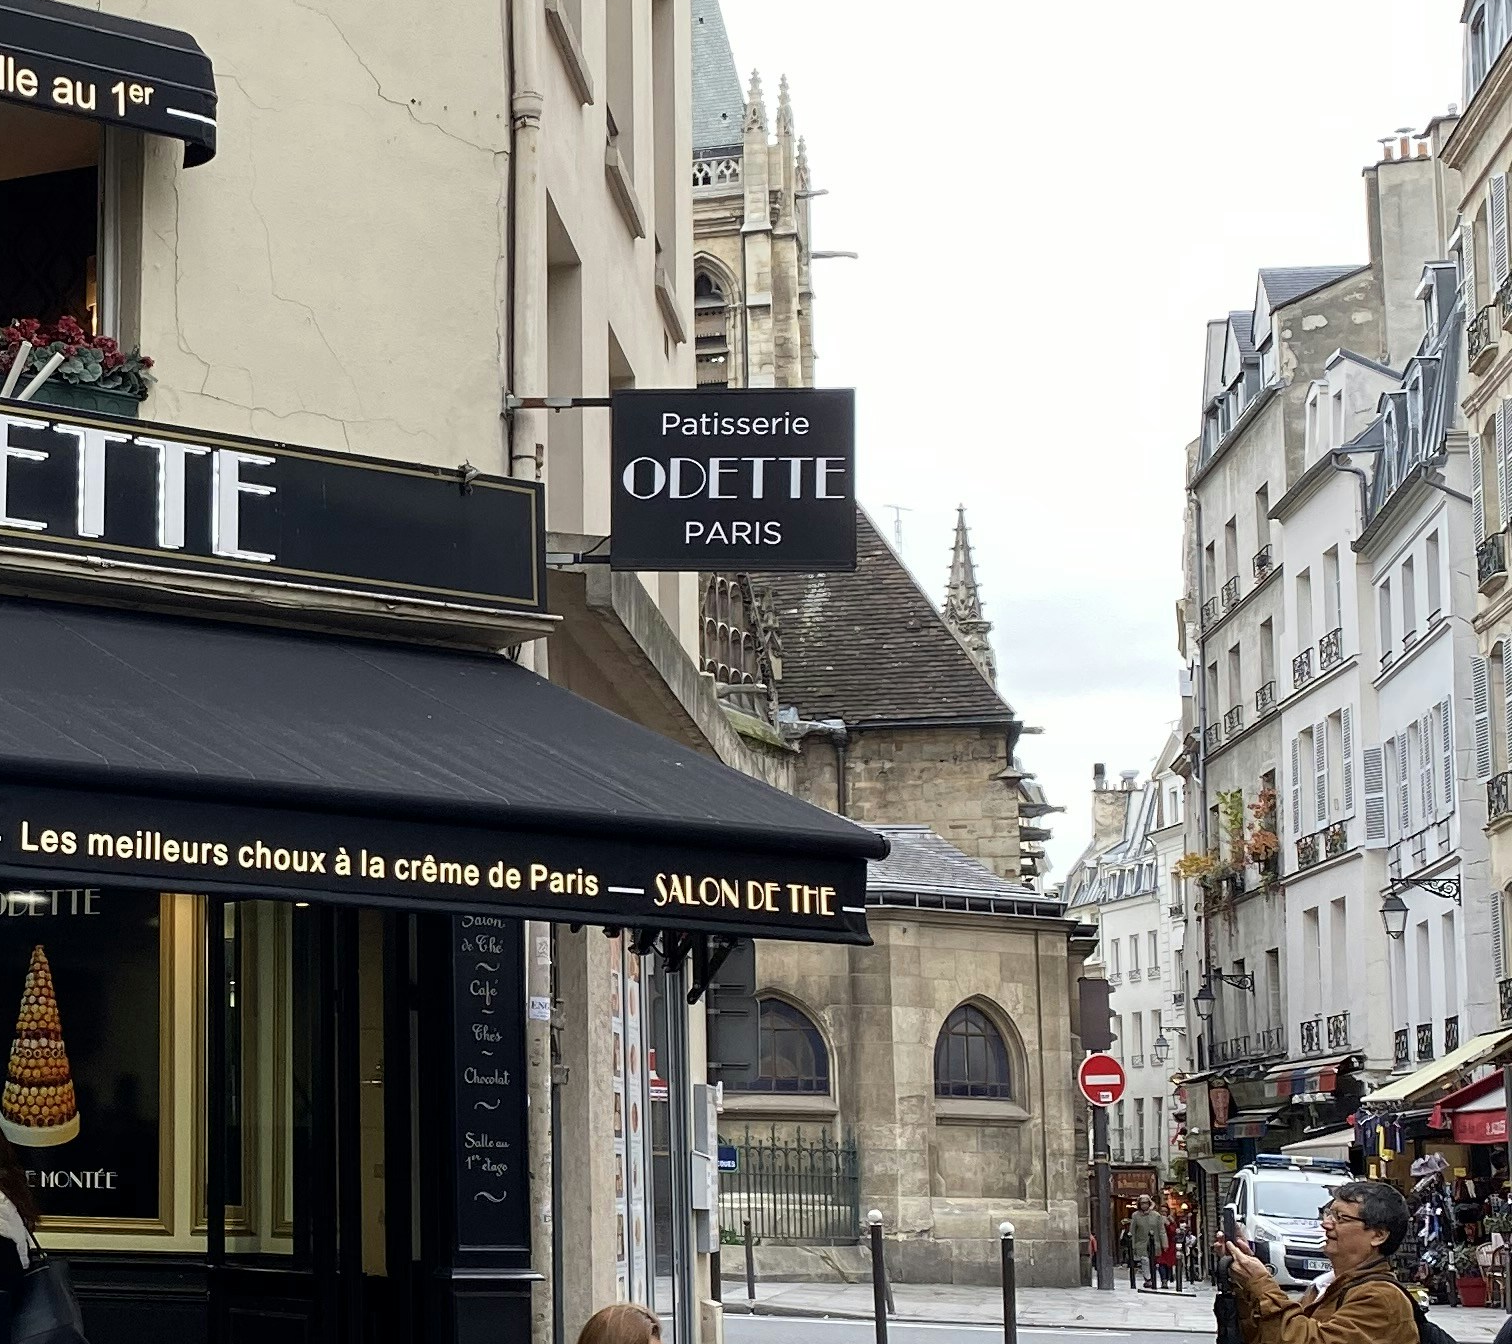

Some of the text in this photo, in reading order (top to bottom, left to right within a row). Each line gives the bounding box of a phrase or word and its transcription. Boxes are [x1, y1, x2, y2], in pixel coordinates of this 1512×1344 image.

[52, 76, 96, 110] au
[111, 81, 154, 117] 1er
[662, 411, 810, 436] Patisserie
[622, 456, 846, 500] ODETTE
[685, 521, 782, 545] PARIS
[21, 820, 77, 855] Les
[88, 830, 229, 866] meilleurs
[238, 840, 327, 874] choux
[335, 847, 351, 876] à
[361, 849, 385, 879] la
[394, 854, 480, 886] crême
[488, 860, 521, 889] de
[530, 863, 599, 897] Paris
[653, 872, 740, 909] SALON
[747, 880, 781, 912] DE
[786, 883, 836, 916] THE
[461, 934, 504, 954] de Thé
[470, 979, 499, 1006] Café
[464, 1067, 511, 1086] Chocolat
[464, 1131, 495, 1149] Salle
[41, 1168, 118, 1190] MONTÉE
